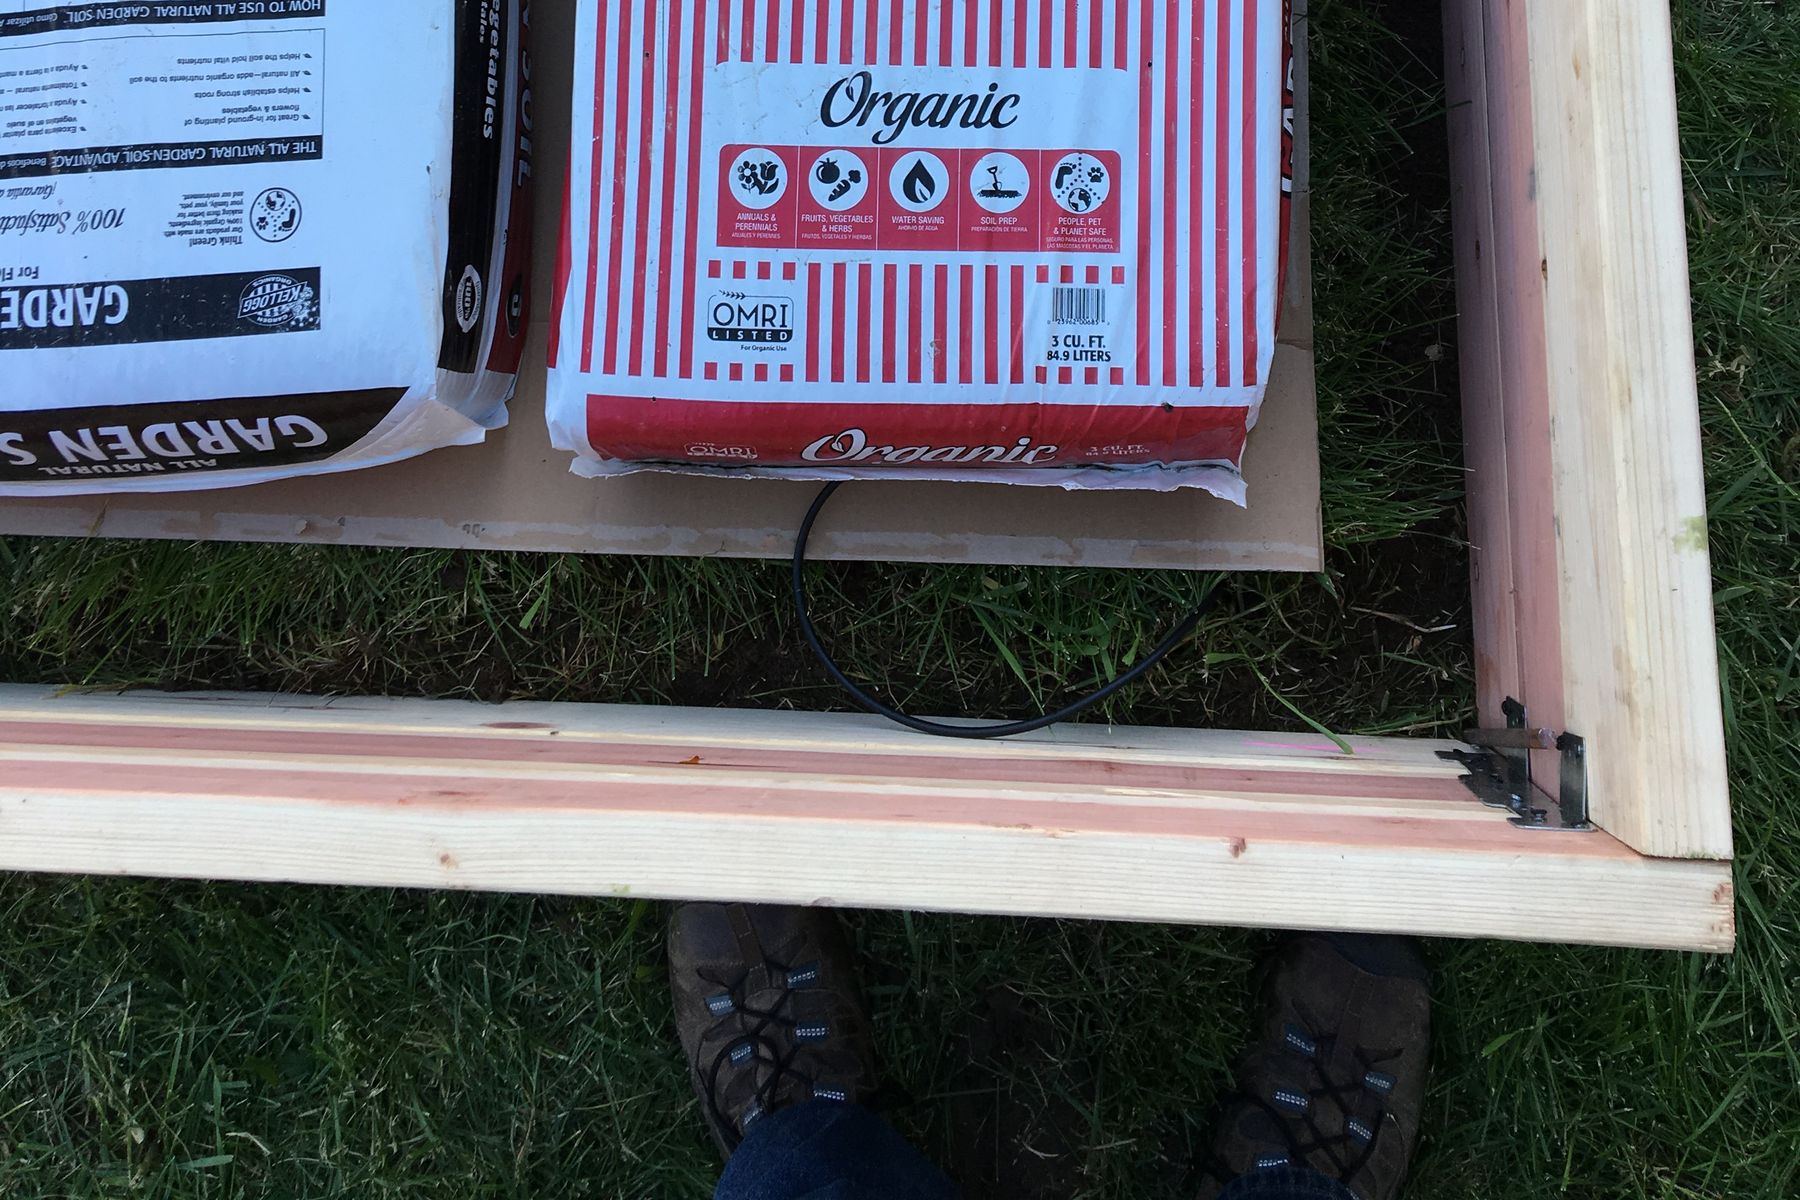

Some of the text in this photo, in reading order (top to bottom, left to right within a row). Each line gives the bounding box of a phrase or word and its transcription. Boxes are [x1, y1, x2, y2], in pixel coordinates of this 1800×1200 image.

[153, 4, 212, 17] NATURAL
[215, 3, 237, 15] ALL
[238, 1, 265, 14] USE
[268, 1, 286, 13] TO
[288, 0, 321, 11] HOW
[66, 9, 93, 23] SOIL
[96, 6, 150, 20] GARDEN
[176, 52, 301, 66] Helps the soil hold vital nutrients
[169, 74, 205, 84] nutrients
[206, 72, 235, 82] organic
[290, 70, 301, 78] All
[129, 76, 143, 85] soil
[144, 76, 158, 84] the
[194, 86, 300, 100] Helps establish strong roots
[221, 104, 262, 115] vegetables
[271, 104, 300, 114] flowers
[820, 70, 1021, 145] Organic
[194, 116, 226, 127] planting
[228, 115, 264, 125] in-ground
[265, 114, 277, 123] for
[278, 113, 300, 122] Great
[209, 144, 265, 159] NATURAL
[267, 142, 290, 154] ALL
[292, 141, 317, 153] THE
[51, 151, 120, 168] ADVANTAGE
[152, 147, 206, 161] GARDEN
[7, 157, 47, 168] Beneficios
[71, 208, 126, 235] 100%
[736, 212, 769, 222] ANNUALS
[801, 214, 874, 224] FRUITS, VEGETABLES
[891, 215, 945, 225] WATER SAVING
[980, 216, 1018, 226] SOIL PREP
[1088, 217, 1102, 226] PET
[735, 222, 778, 232] PERENNIALS
[829, 224, 853, 233] HERBS
[1060, 227, 1088, 236] PLANET
[1088, 227, 1107, 237] SAFE
[188, 235, 243, 247] Think Green!
[0, 266, 40, 281] For Fl
[252, 276, 292, 287] ORGANICS
[241, 285, 302, 313] KELLOGG
[256, 313, 288, 323] GARDEN
[713, 302, 788, 328] OMRI
[712, 330, 788, 341] LISTED
[1051, 334, 1106, 348] 3 CU. FT.
[752, 344, 775, 352] Organic
[1046, 349, 1112, 362] 84.9 LITERS
[48, 414, 328, 464] GARDEN
[690, 445, 752, 456] OMRI
[802, 428, 1058, 465] Organic
[38, 458, 217, 477] ALL NATURAL
